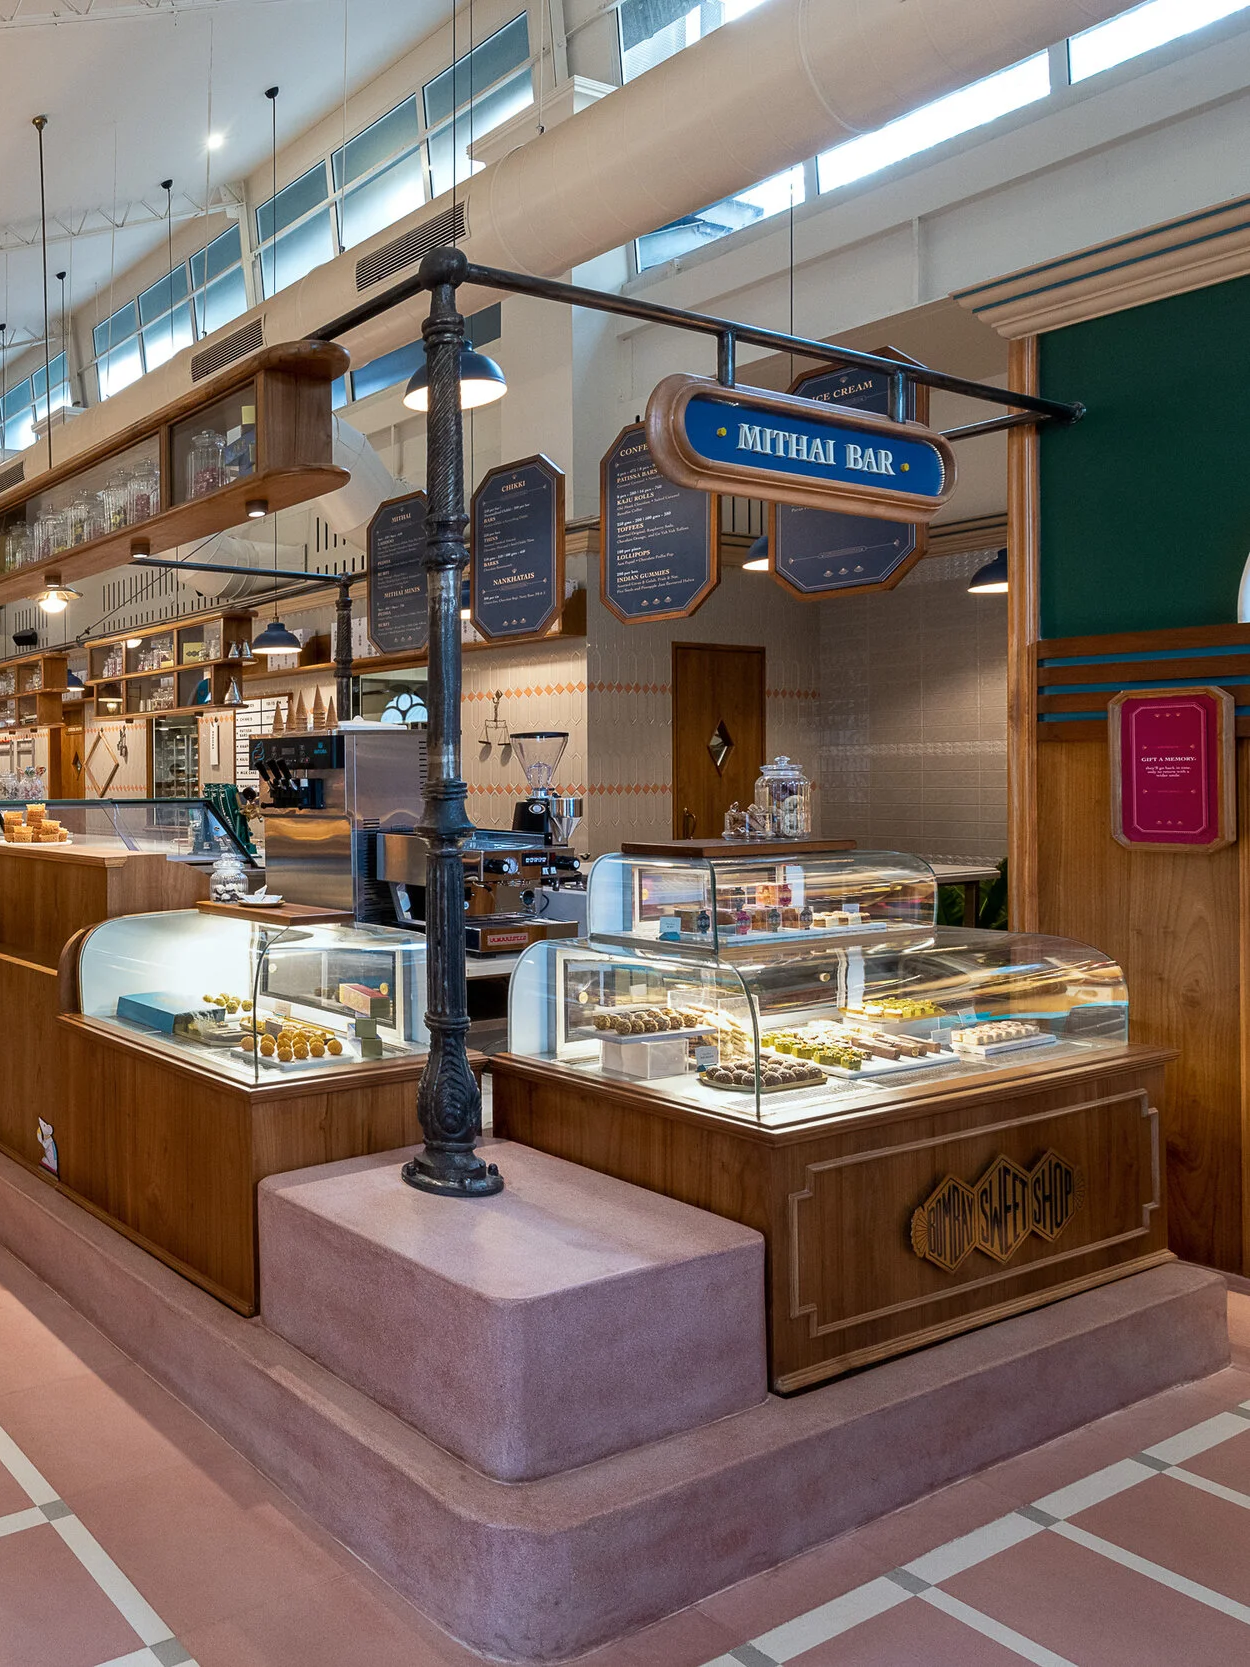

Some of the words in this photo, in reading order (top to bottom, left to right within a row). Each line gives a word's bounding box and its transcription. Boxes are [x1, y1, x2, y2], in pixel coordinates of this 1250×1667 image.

[833, 380, 873, 398] CREAM
[736, 423, 837, 465] MITHAI
[844, 443, 896, 476] BAR
[616, 472, 640, 483] PATISSA
[641, 468, 657, 477] BARS
[501, 480, 526, 493] CHIKKI
[616, 497, 632, 505] KAJU
[634, 492, 654, 501] ROLLS
[616, 522, 643, 532] TOFFEES
[616, 550, 650, 560] LOLLIPOPS
[493, 572, 535, 586] NANKHATAIS
[616, 574, 638, 582] INDIAN
[640, 568, 669, 578] GUMMIES
[927, 1183, 975, 1265] BOMBAY
[979, 1164, 1029, 1255] SWEET
[1032, 1158, 1073, 1235] SHOP
